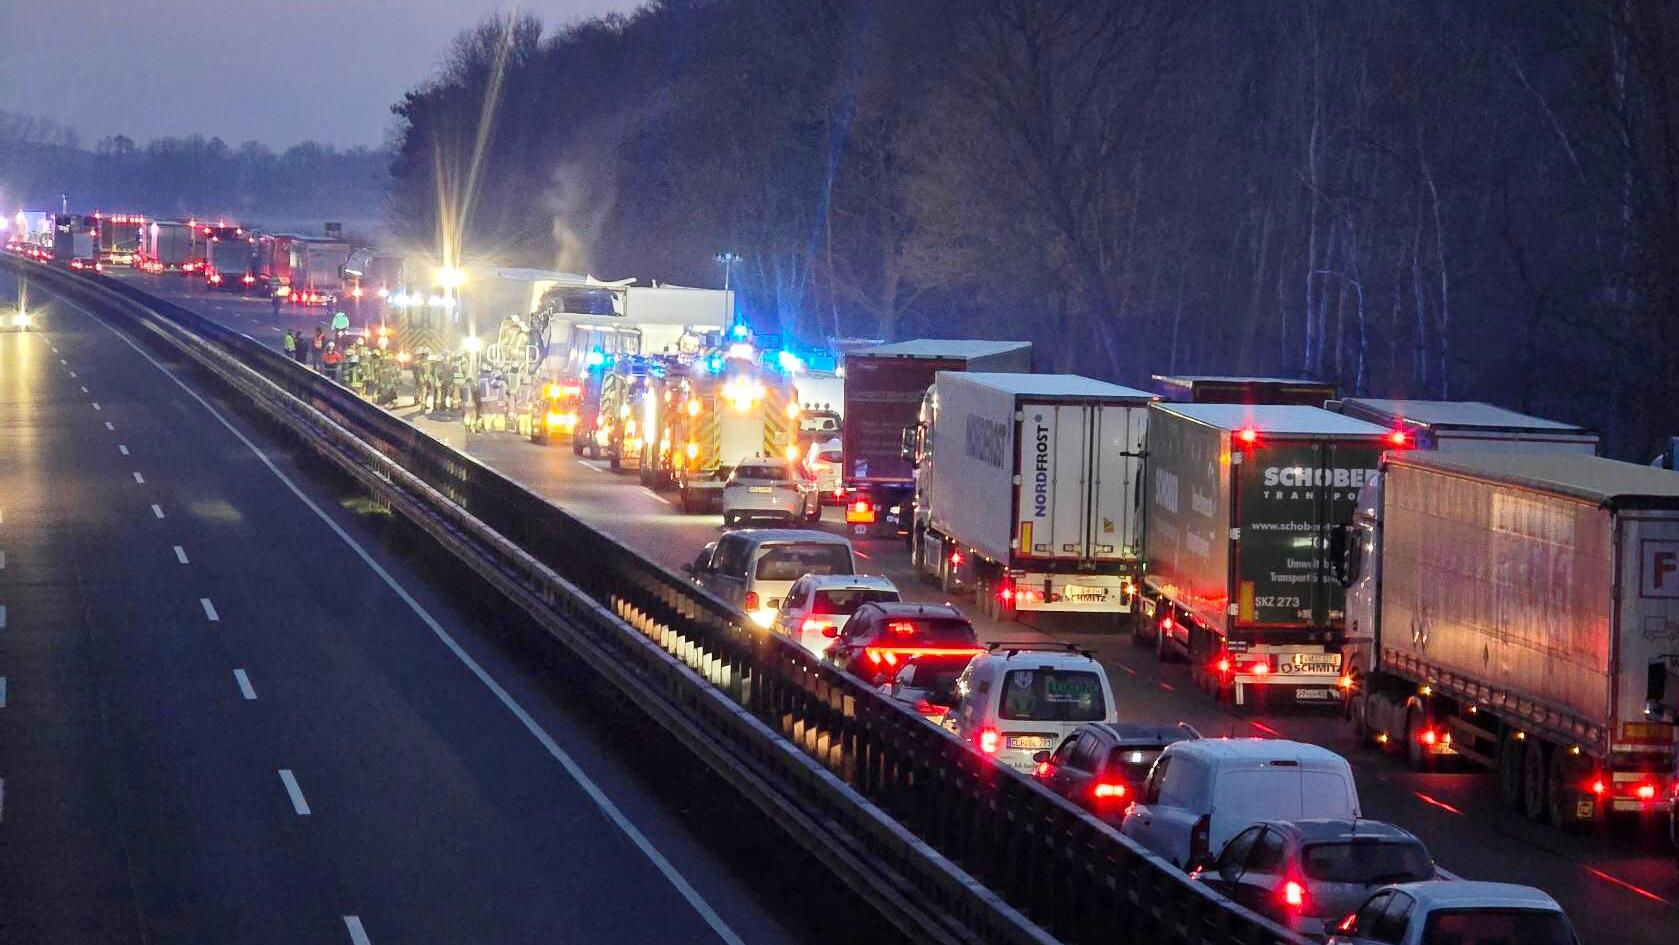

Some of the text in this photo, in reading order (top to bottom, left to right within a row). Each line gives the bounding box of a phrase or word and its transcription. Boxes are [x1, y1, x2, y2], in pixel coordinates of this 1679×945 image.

[1034, 425, 1049, 518] NORDFROST
[1255, 596, 1300, 608] SKZ 273
